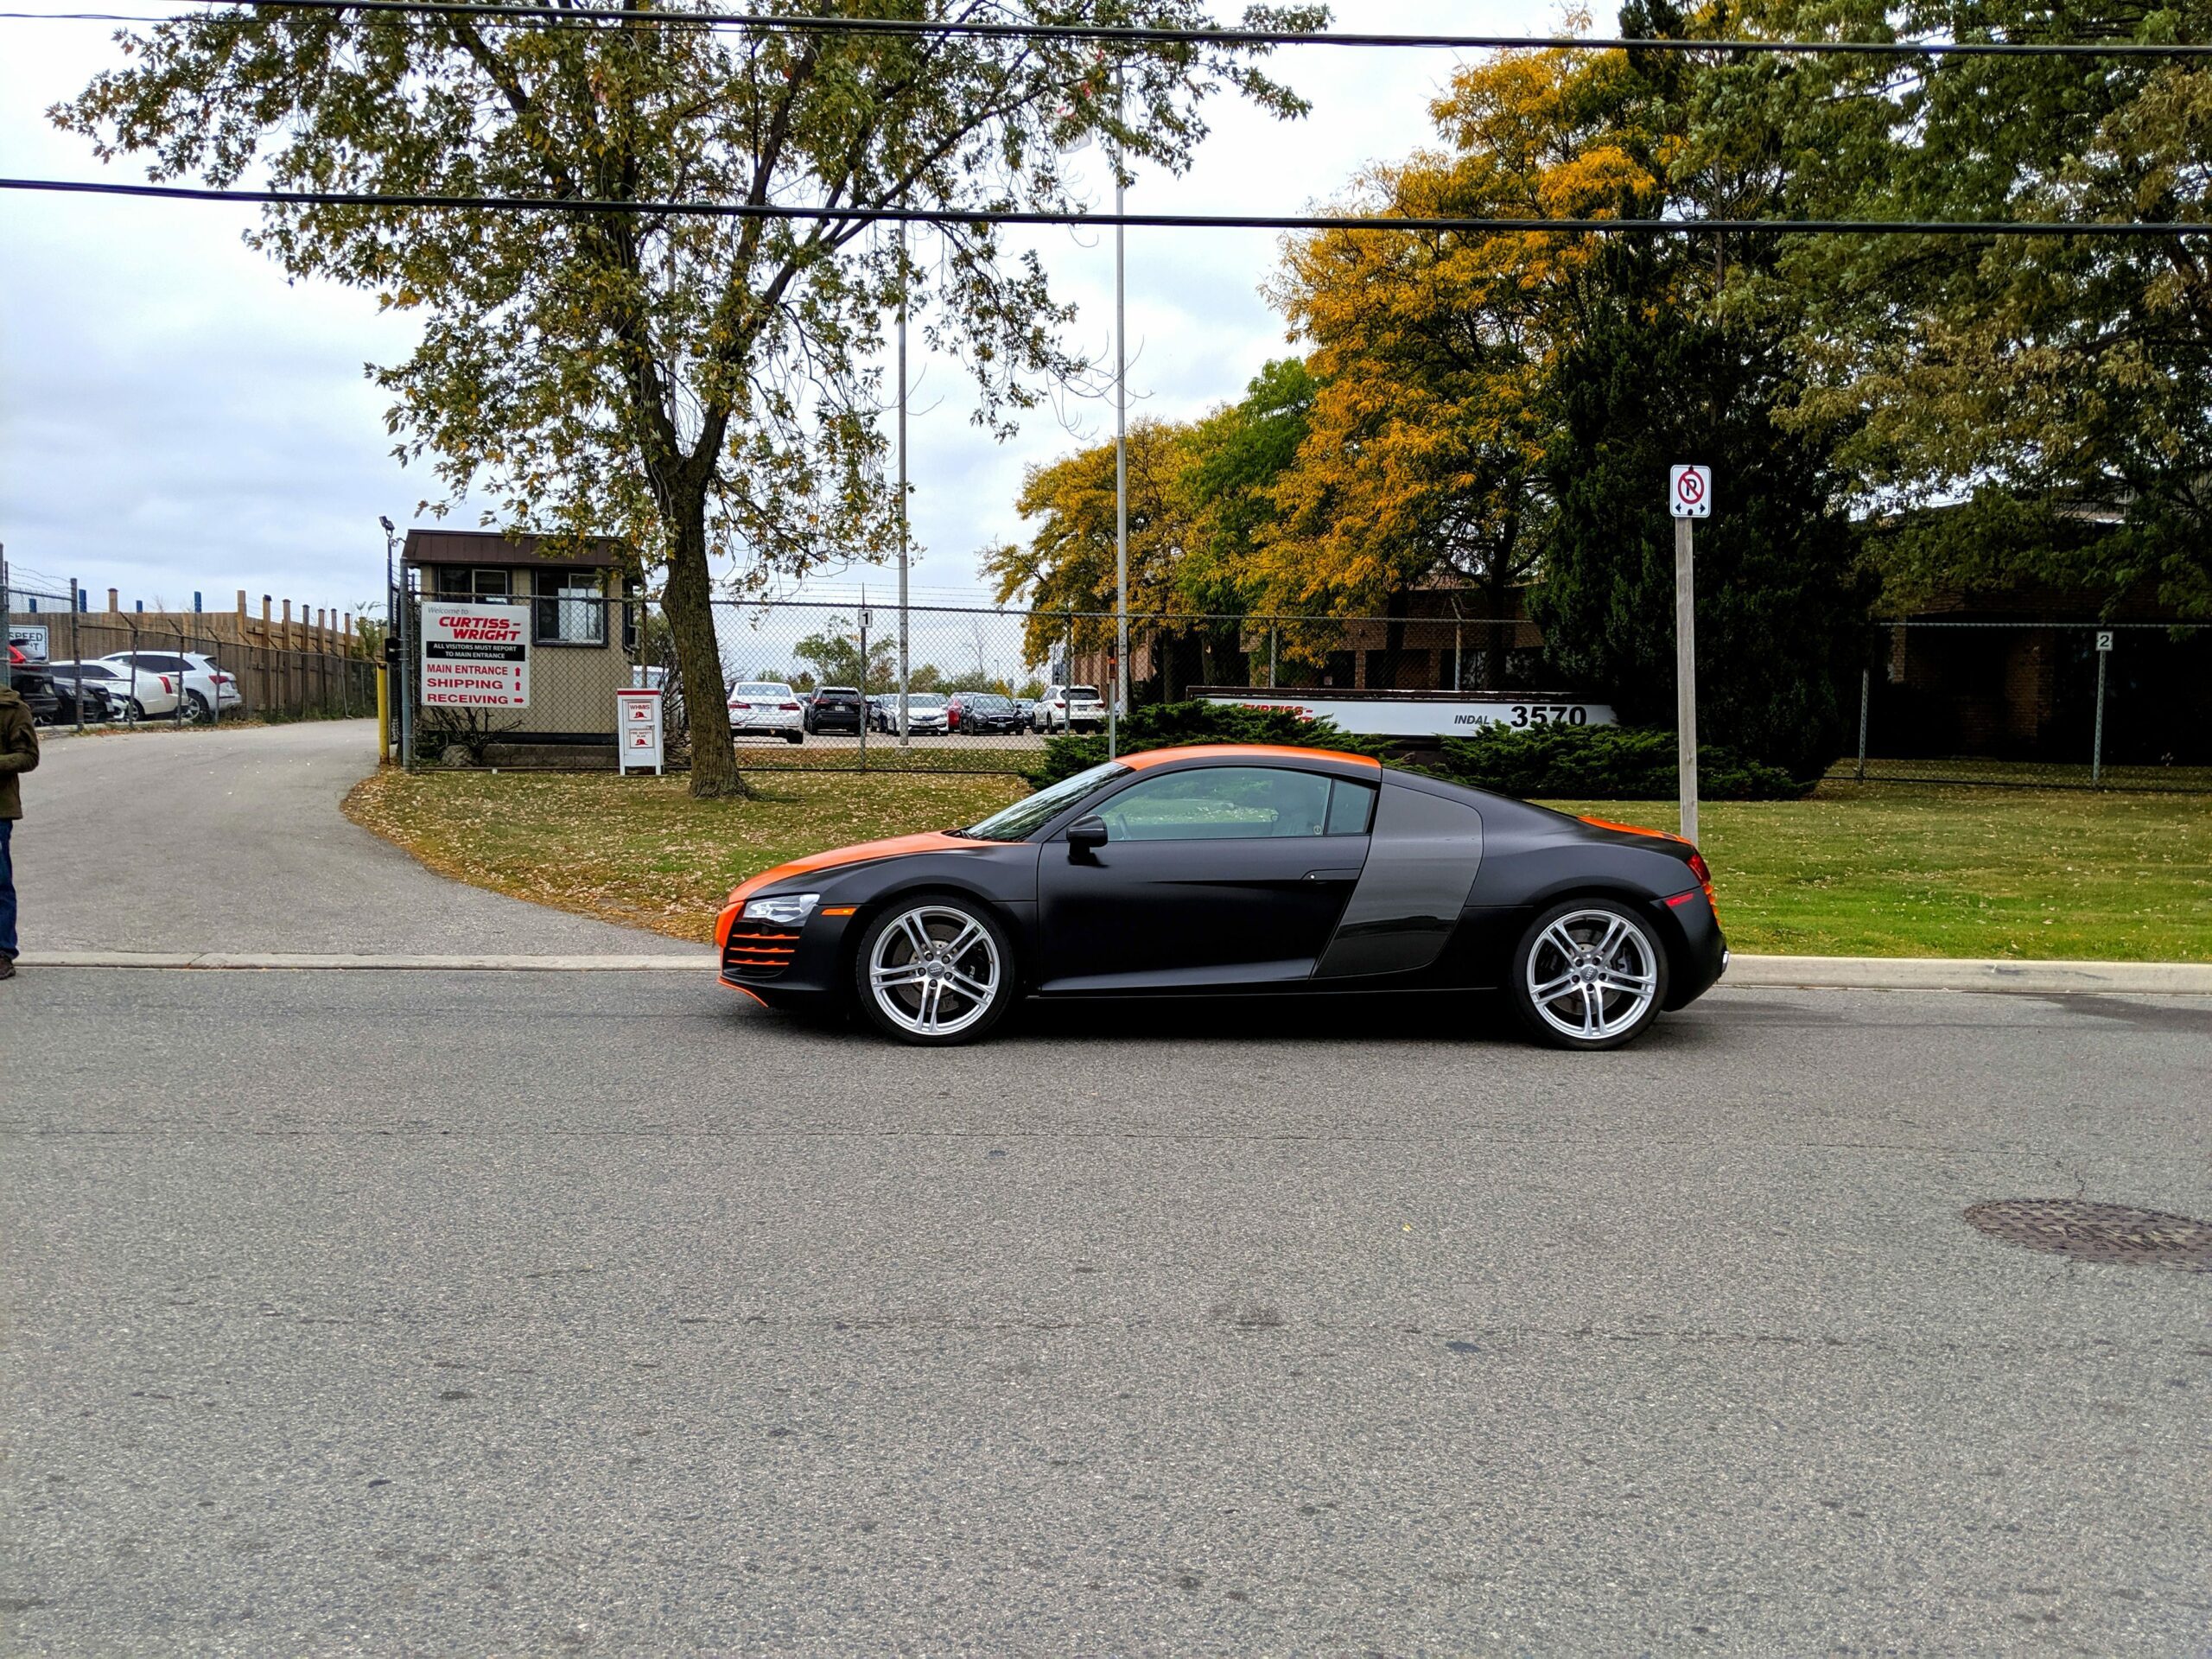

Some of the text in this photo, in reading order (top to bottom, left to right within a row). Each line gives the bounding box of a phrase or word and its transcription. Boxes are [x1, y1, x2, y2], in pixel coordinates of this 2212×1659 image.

[862, 612, 868, 625] 1
[453, 629, 521, 641] WRIGHT
[2100, 635, 2109, 647] 2
[427, 664, 508, 675] MAIN ENTRANCE
[427, 678, 503, 690] SHIPPING
[427, 693, 509, 704] RECEIVING
[1453, 705, 1587, 728] INDAL 3570
